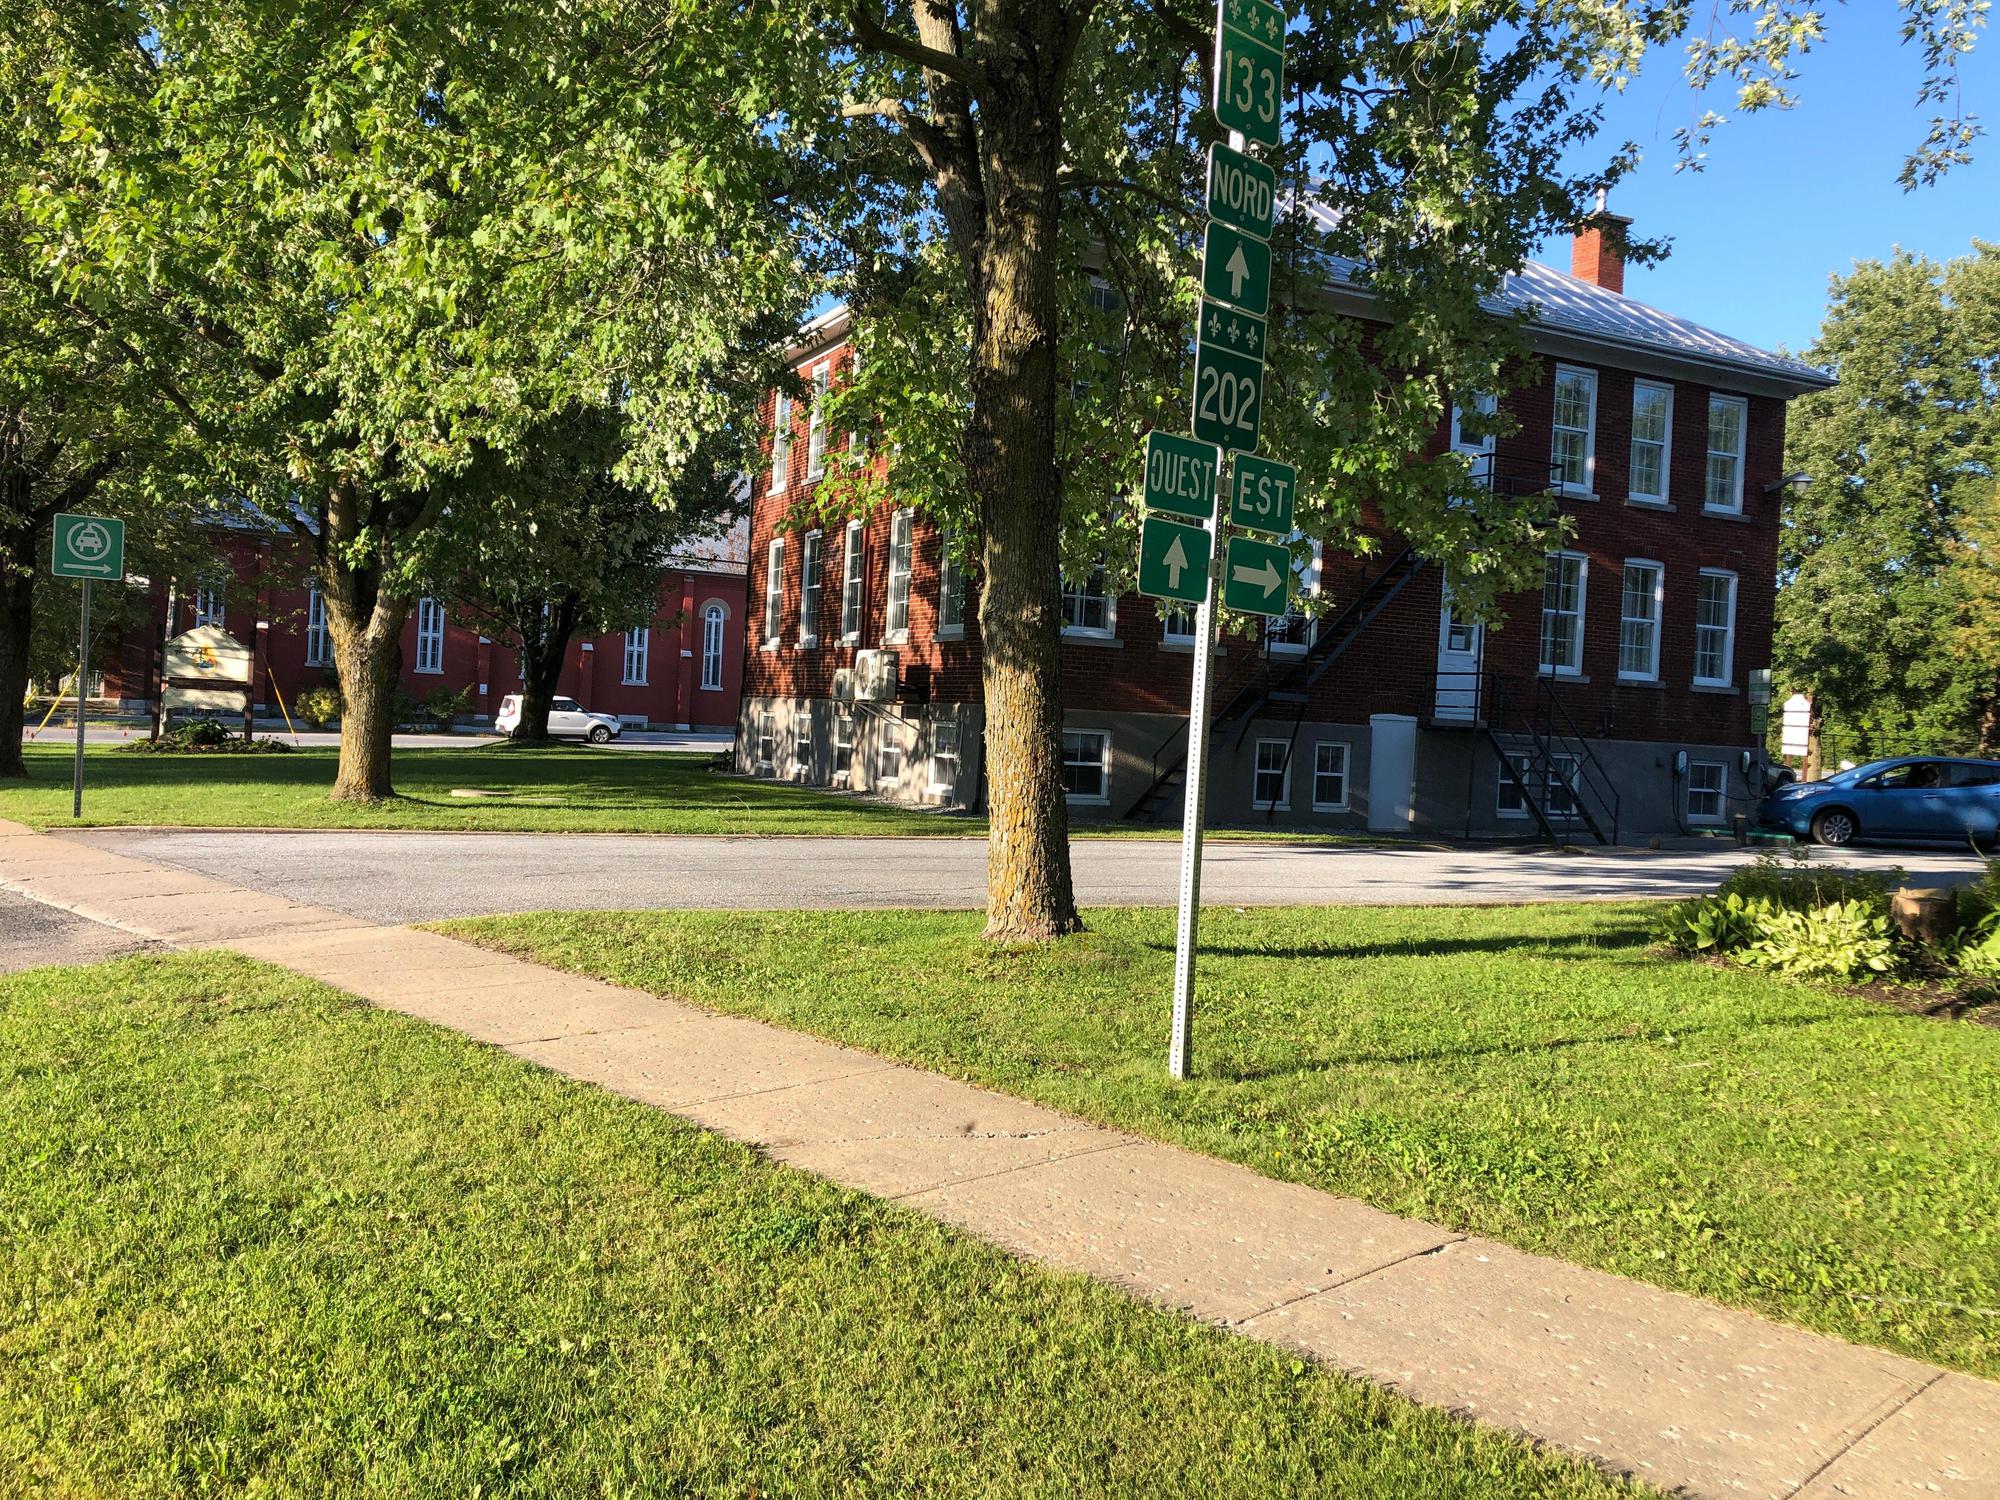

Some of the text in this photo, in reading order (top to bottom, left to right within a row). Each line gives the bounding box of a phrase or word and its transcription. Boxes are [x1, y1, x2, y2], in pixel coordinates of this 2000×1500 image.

[1225, 49, 1275, 123] 133
[1213, 160, 1270, 221] NORD
[1199, 366, 1256, 431] 202
[1152, 449, 1213, 501] OUEST
[1239, 471, 1288, 517] EST
